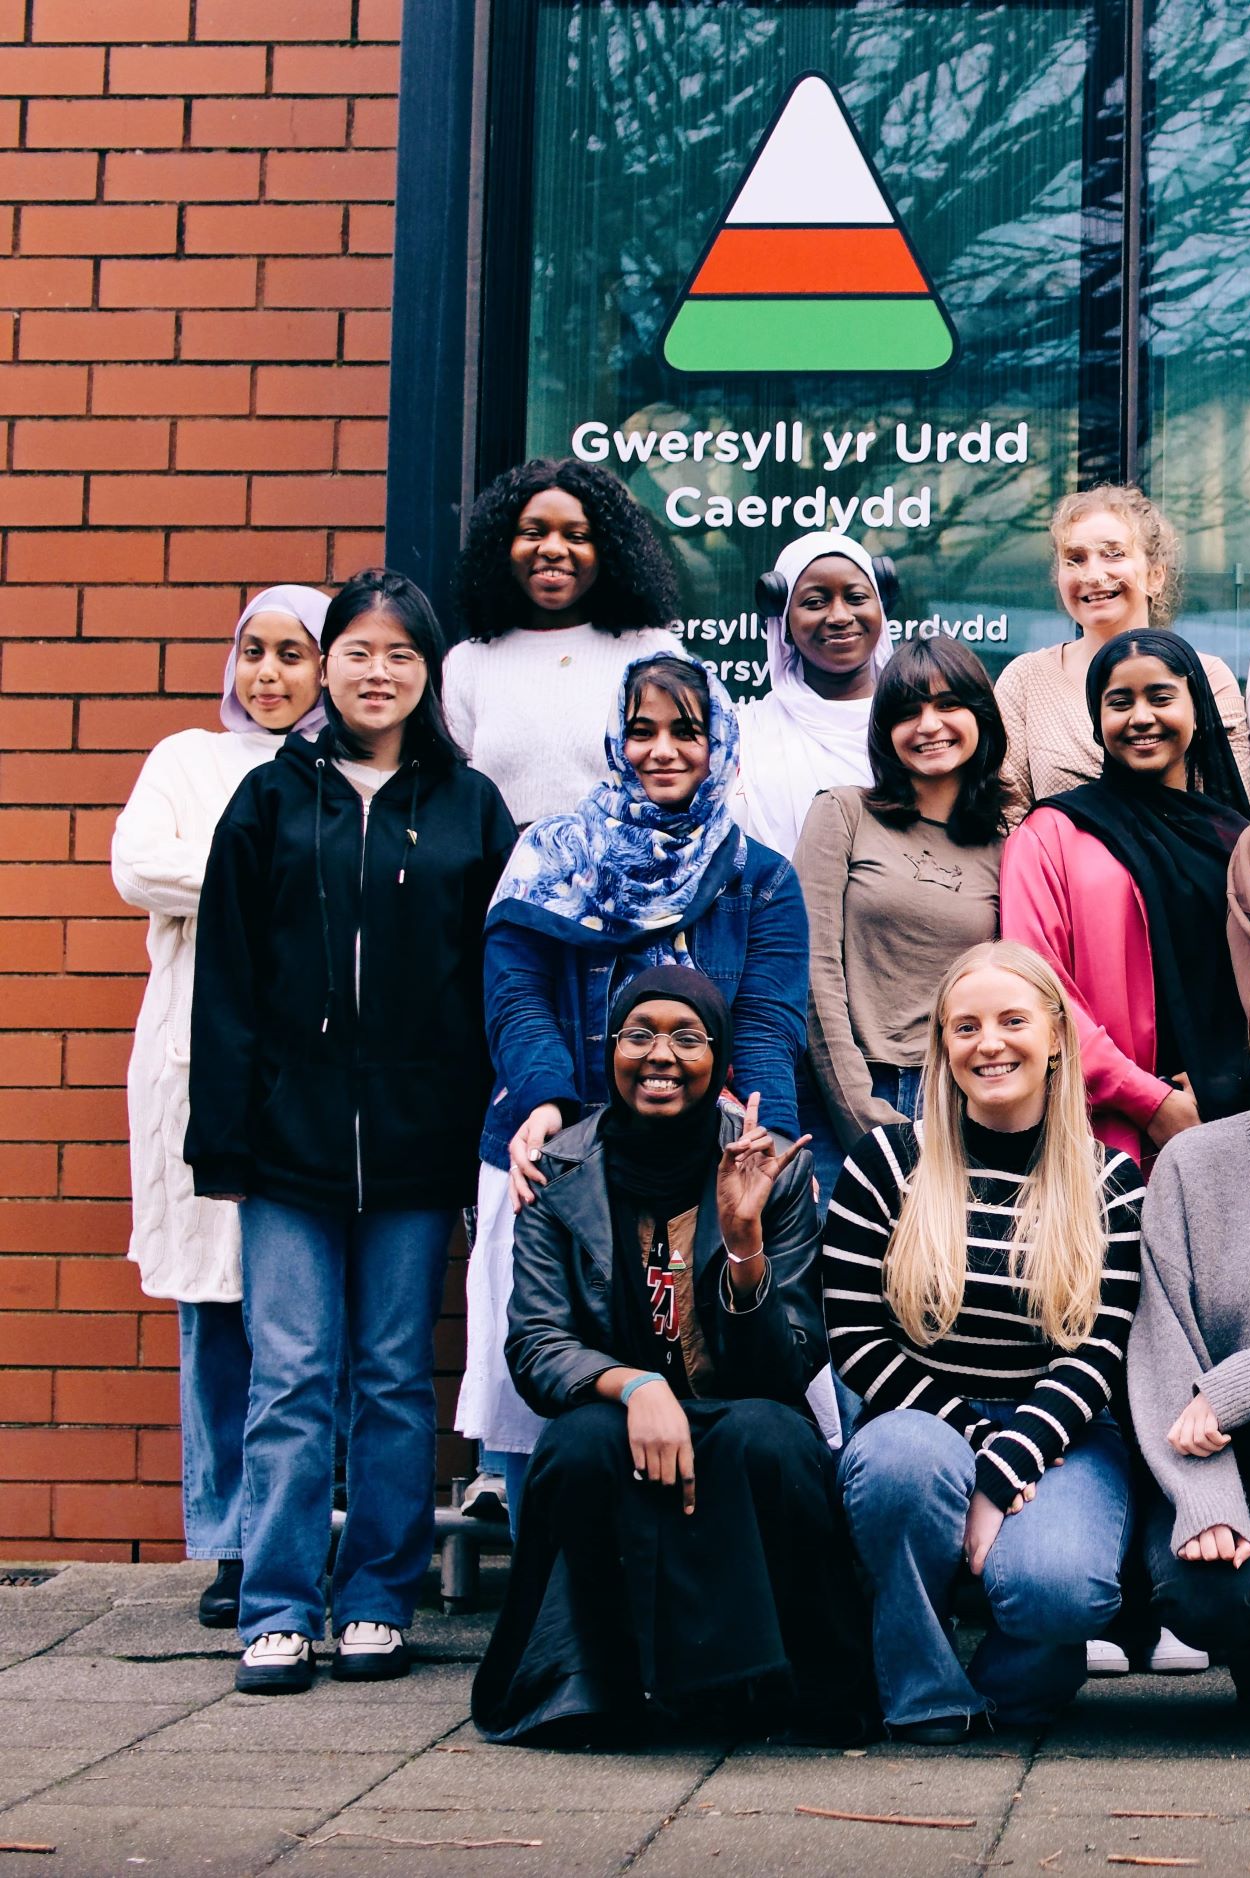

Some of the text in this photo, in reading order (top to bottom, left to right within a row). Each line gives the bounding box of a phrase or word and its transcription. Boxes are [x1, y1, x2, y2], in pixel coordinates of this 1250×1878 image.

[571, 421, 1029, 472] Gwersyll yr Urdd
[665, 485, 931, 534] Caerdydd
[671, 612, 1008, 645] ersyll erdydd
